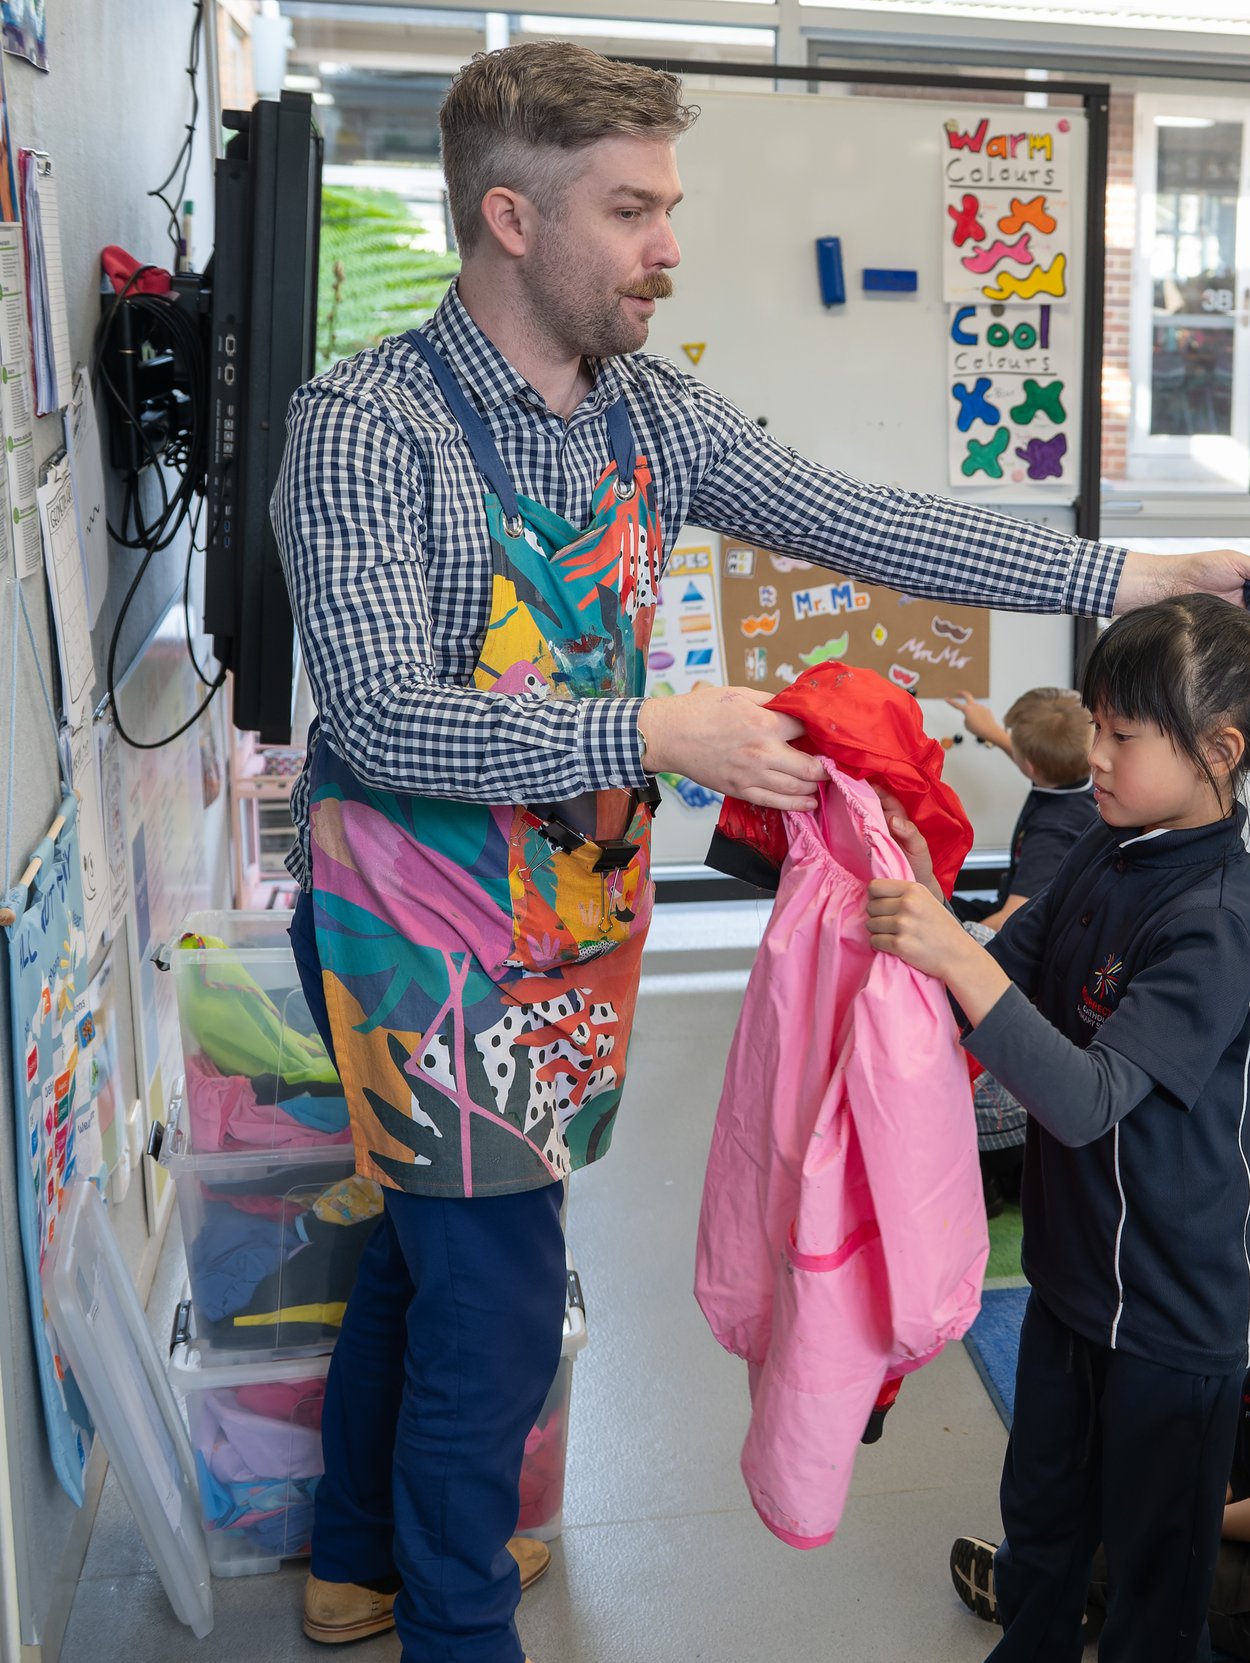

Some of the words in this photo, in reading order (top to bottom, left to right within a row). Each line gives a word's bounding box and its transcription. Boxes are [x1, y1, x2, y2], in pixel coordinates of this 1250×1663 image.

[943, 118, 1053, 161] Warm
[946, 158, 1054, 185] Colours
[1201, 288, 1233, 311] 3B
[951, 304, 1050, 350] Cool
[954, 352, 1050, 371] Colours
